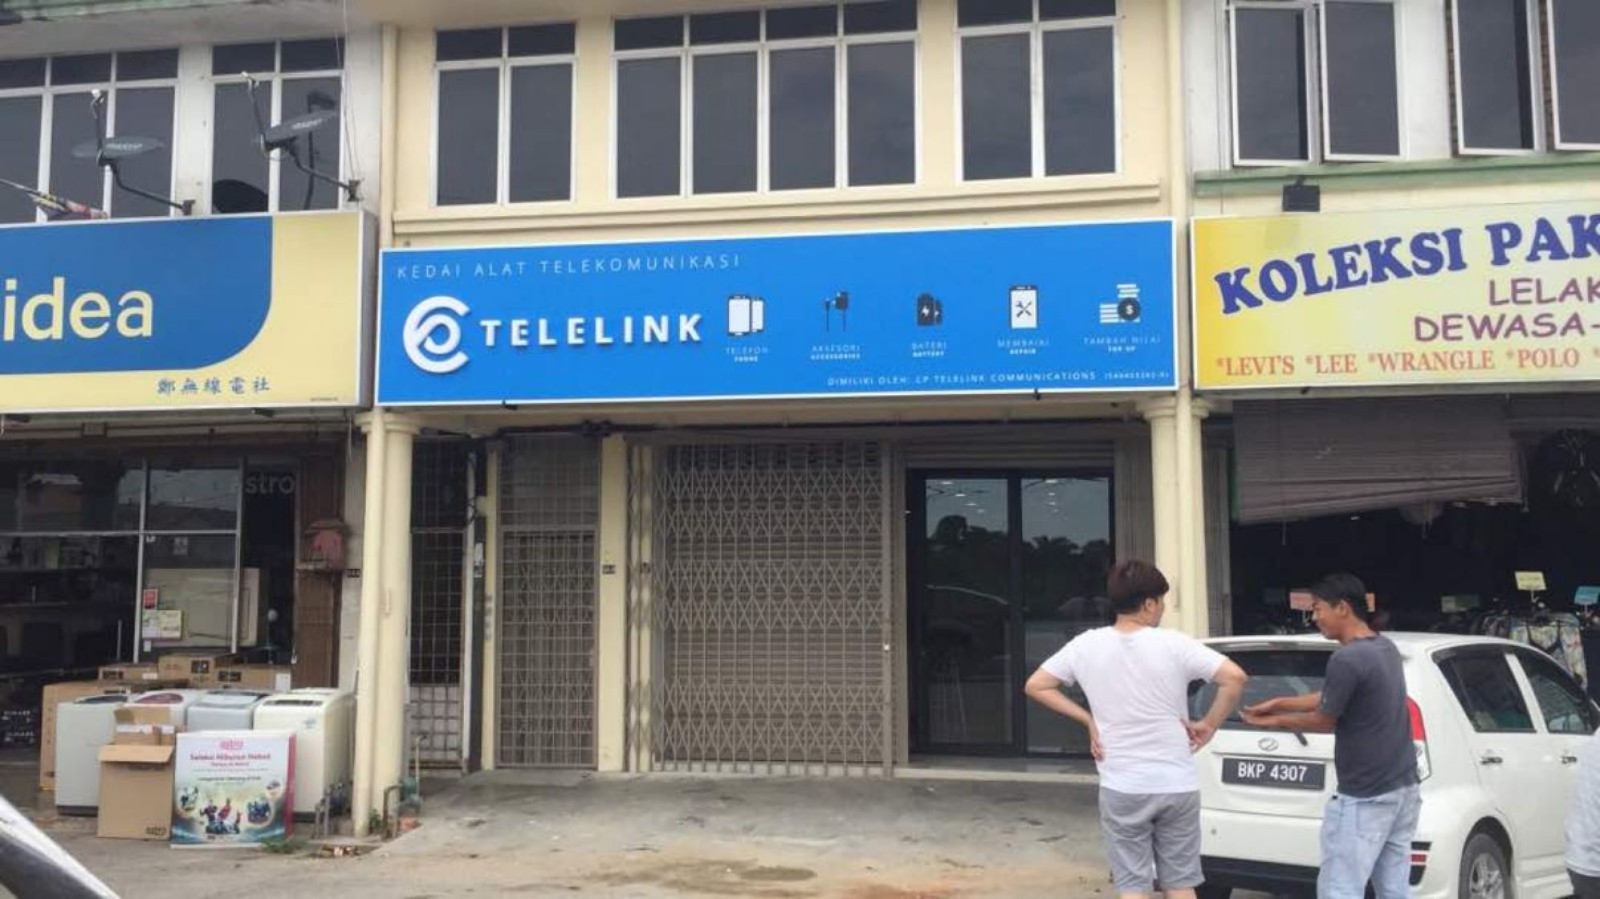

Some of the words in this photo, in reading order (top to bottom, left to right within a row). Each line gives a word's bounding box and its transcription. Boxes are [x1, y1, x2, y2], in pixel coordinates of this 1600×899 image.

[397, 264, 461, 279] KEDAI
[474, 262, 527, 277] ALAT
[540, 254, 741, 274] TELEKOMUNIKASI
[1214, 228, 1468, 315] KOLEKSI
[1484, 213, 1600, 266] PAK
[3, 276, 153, 341] idea
[480, 313, 702, 347] TELELINK
[827, 377, 874, 386] DIMILIKI
[934, 374, 985, 384] TELELINK
[990, 372, 1096, 382] COMMUNICATIONS
[1237, 762, 1266, 779] BKP
[1269, 765, 1308, 782] 4307
